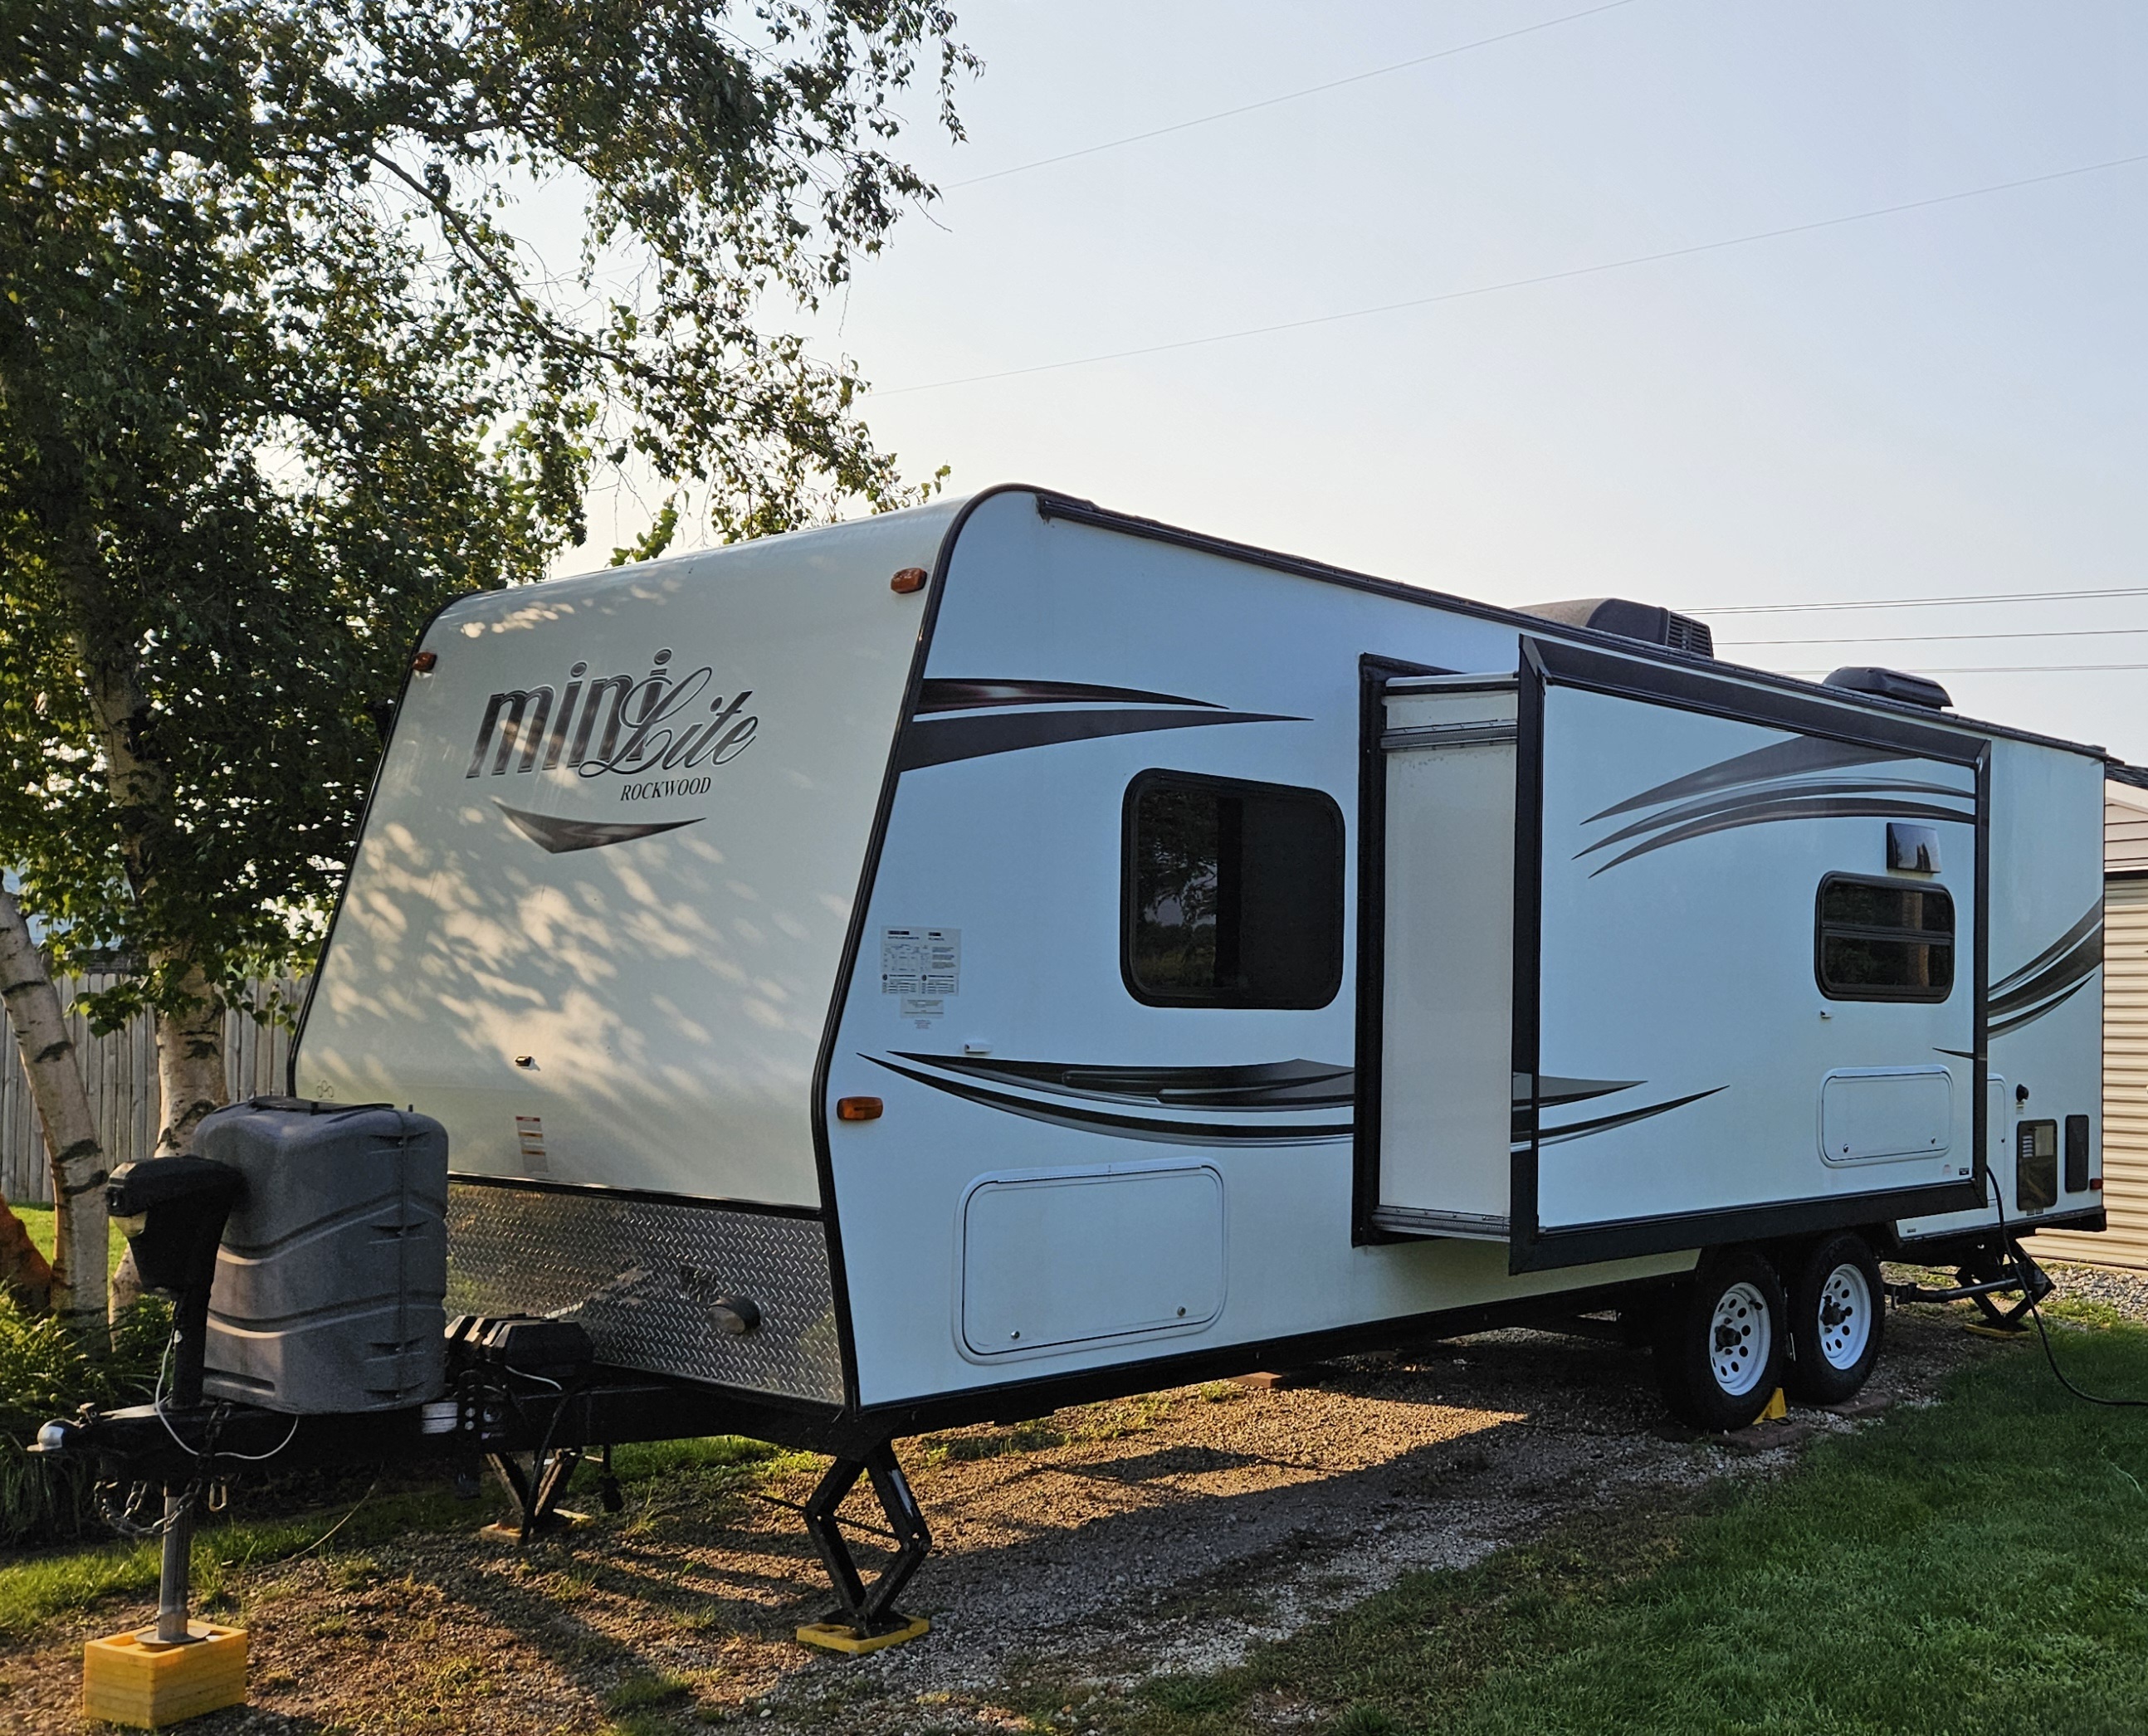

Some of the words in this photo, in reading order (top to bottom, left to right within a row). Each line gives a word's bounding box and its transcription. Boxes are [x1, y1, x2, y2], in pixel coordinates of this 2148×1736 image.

[465, 648, 672, 779] mini
[578, 666, 759, 778] Lite
[619, 777, 712, 802] ROCKWOOD
